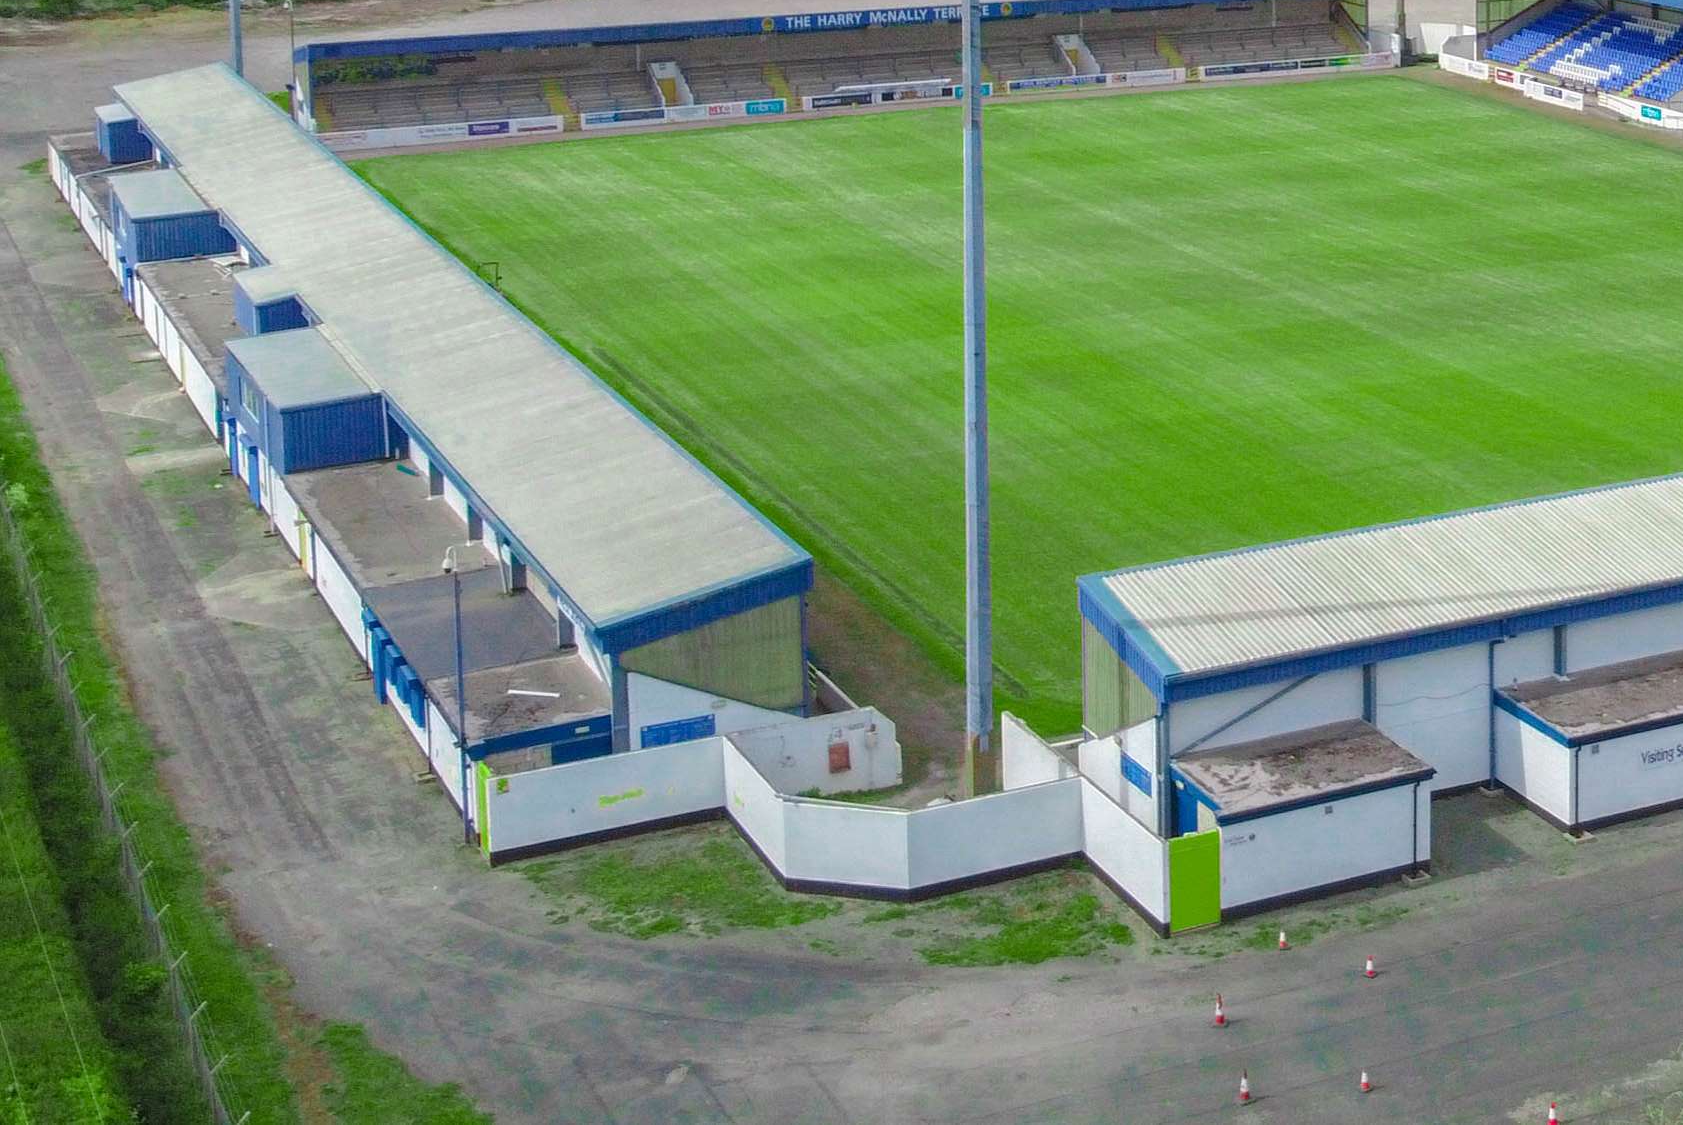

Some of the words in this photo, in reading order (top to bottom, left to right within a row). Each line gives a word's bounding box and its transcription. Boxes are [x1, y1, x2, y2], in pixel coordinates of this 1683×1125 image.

[786, 16, 811, 29] THE
[817, 12, 863, 27] HARRY
[869, 8, 928, 24] McNALLY
[933, 4, 990, 20] TERRE
[1641, 747, 1674, 764] Visiting
